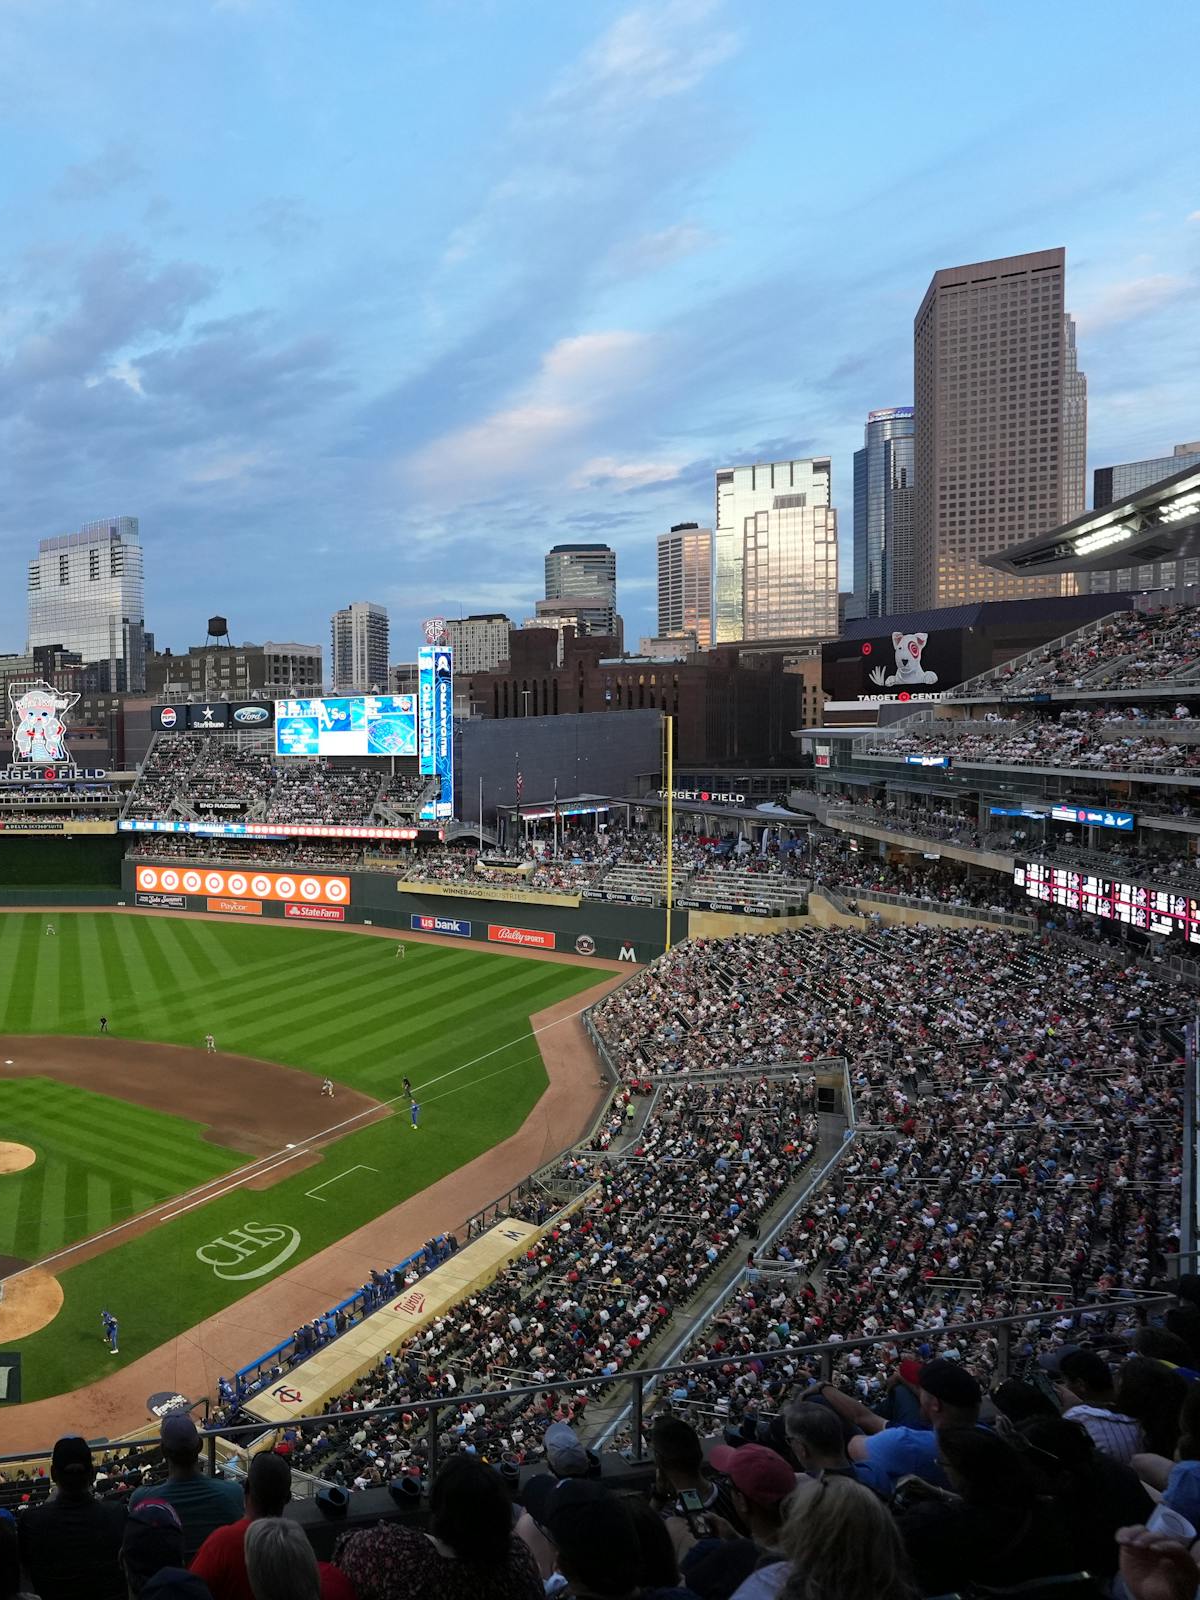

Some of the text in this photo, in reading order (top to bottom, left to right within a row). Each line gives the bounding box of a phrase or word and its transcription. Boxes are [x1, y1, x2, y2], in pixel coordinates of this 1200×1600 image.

[857, 694, 898, 702] TARGET
[241, 711, 261, 721] Ford
[59, 768, 106, 779] FIELD
[657, 790, 745, 802] TARGET FIELD
[442, 888, 527, 900] WINNEBAGO INDUSTRIES
[583, 890, 602, 898] Corona
[606, 893, 626, 901] Corona
[631, 895, 652, 903] Corona
[221, 902, 248, 911] Paycor
[677, 899, 699, 908] Corona
[710, 902, 733, 911] Corona
[301, 907, 340, 918] State Farm
[744, 905, 767, 914] Corona
[421, 919, 460, 932] us bank
[498, 928, 545, 943] Bally SPORTS
[618, 946, 636, 962] M
[195, 1222, 286, 1266] CHS
[394, 1291, 424, 1315] Twins
